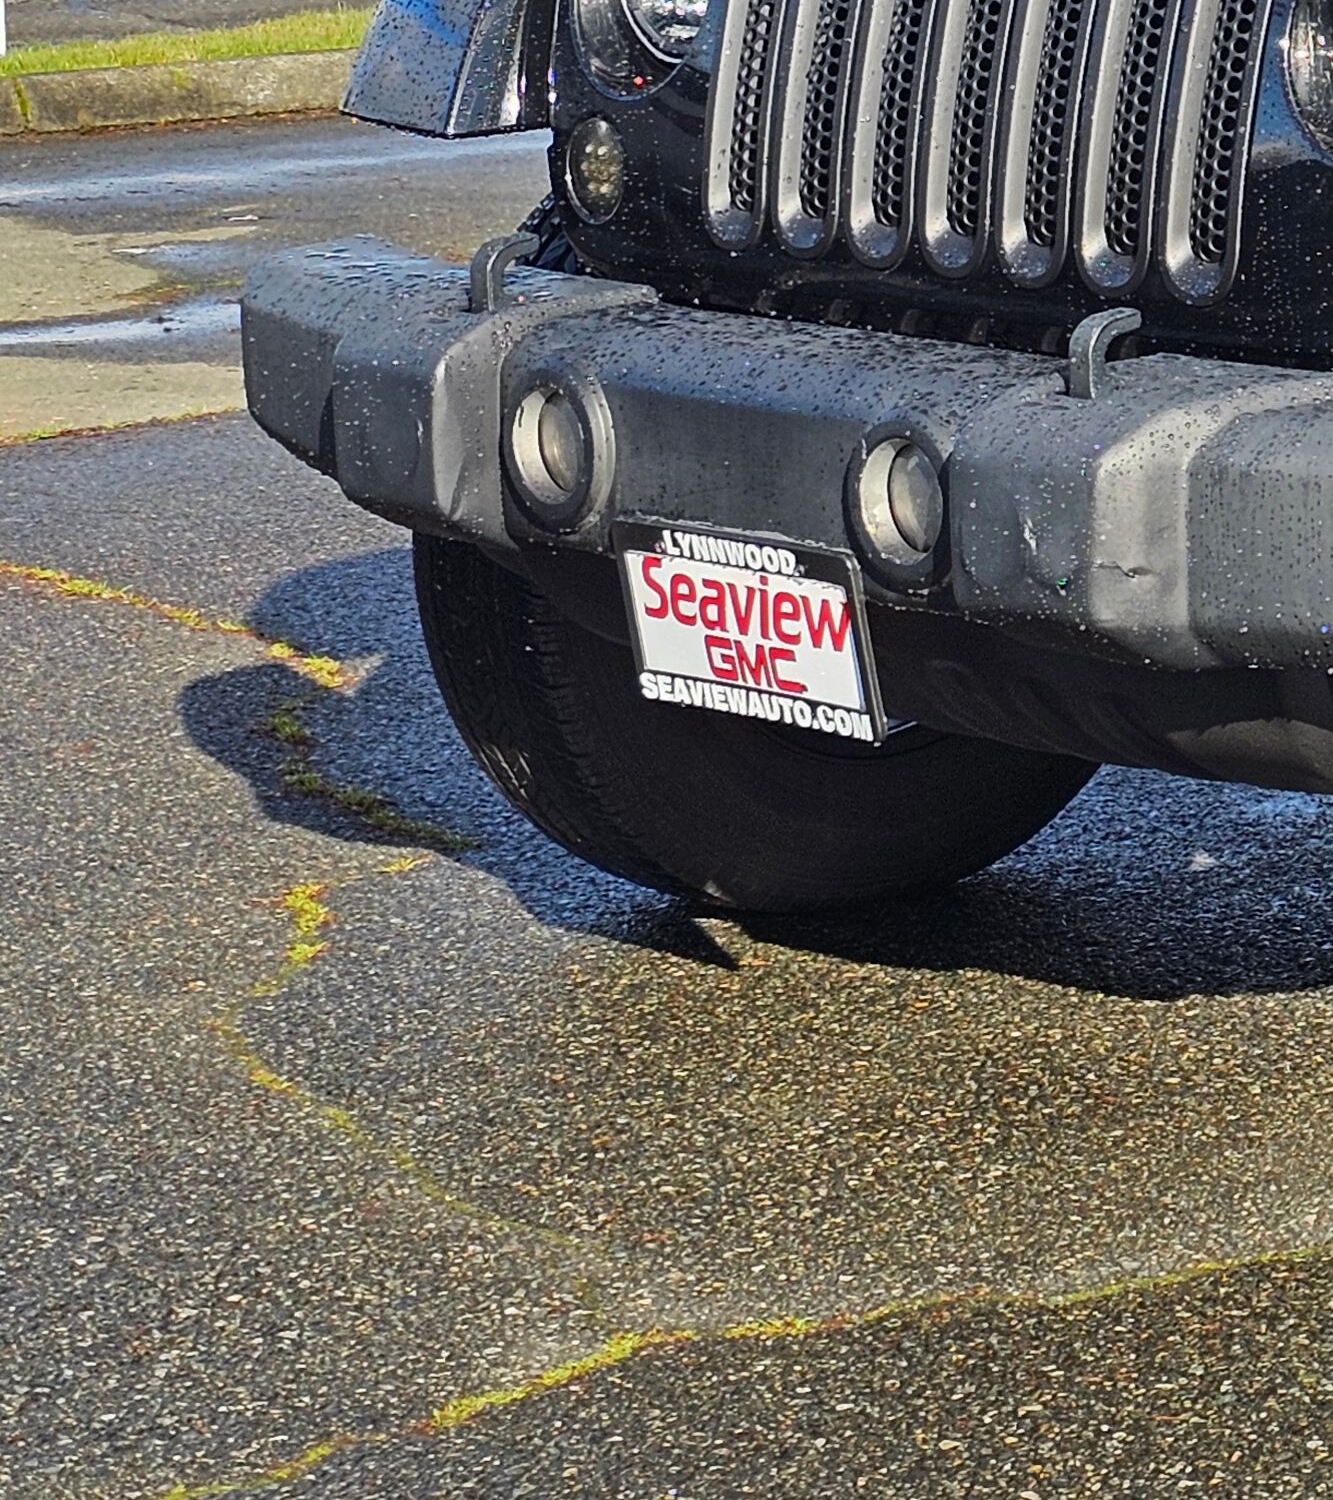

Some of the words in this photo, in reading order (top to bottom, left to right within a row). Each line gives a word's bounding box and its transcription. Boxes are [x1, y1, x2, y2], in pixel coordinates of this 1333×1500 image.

[661, 529, 799, 576] LYNNWOOD
[641, 555, 851, 652] Seaview
[704, 634, 808, 693] GMC
[639, 671, 874, 742] SEAVIEWAUTO.COM
